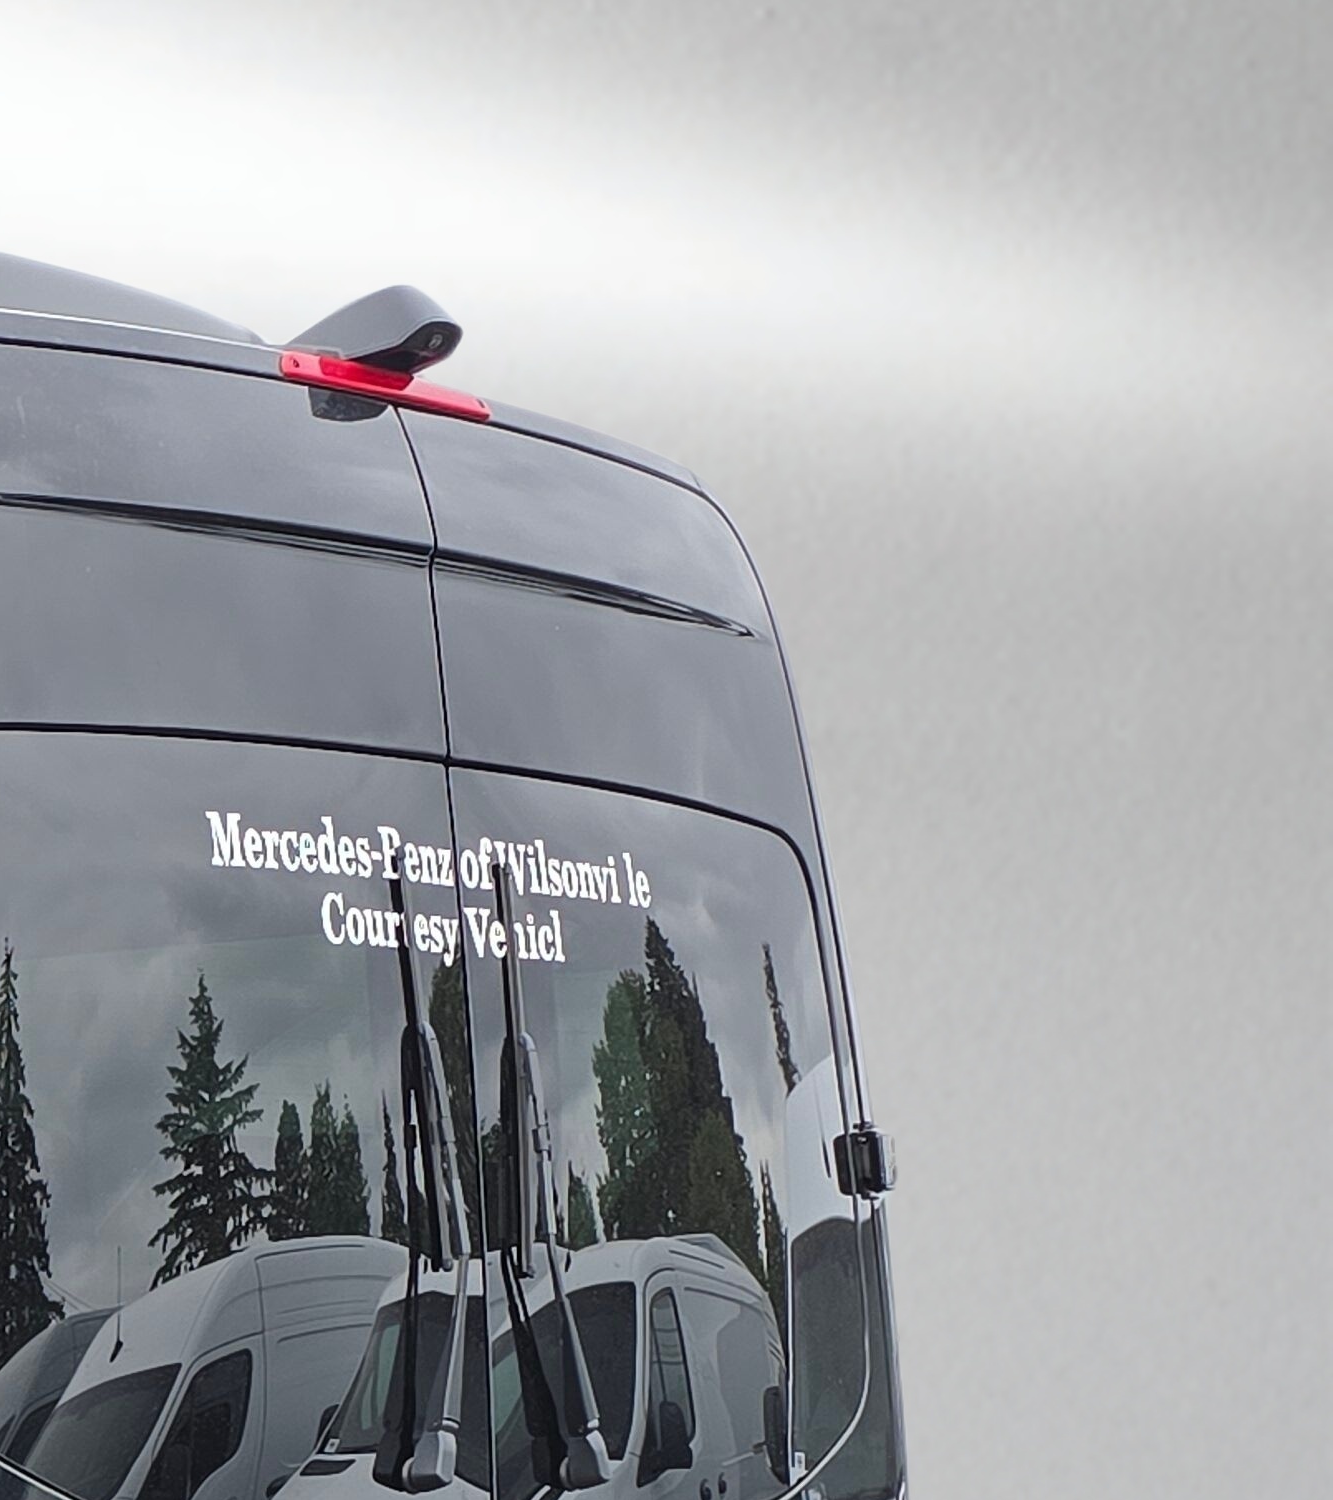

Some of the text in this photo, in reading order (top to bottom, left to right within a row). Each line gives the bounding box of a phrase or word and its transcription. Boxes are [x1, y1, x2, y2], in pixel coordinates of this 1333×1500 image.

[460, 836, 493, 891] of
[493, 839, 652, 909] Wilsonvile
[321, 892, 460, 968] Couresy
